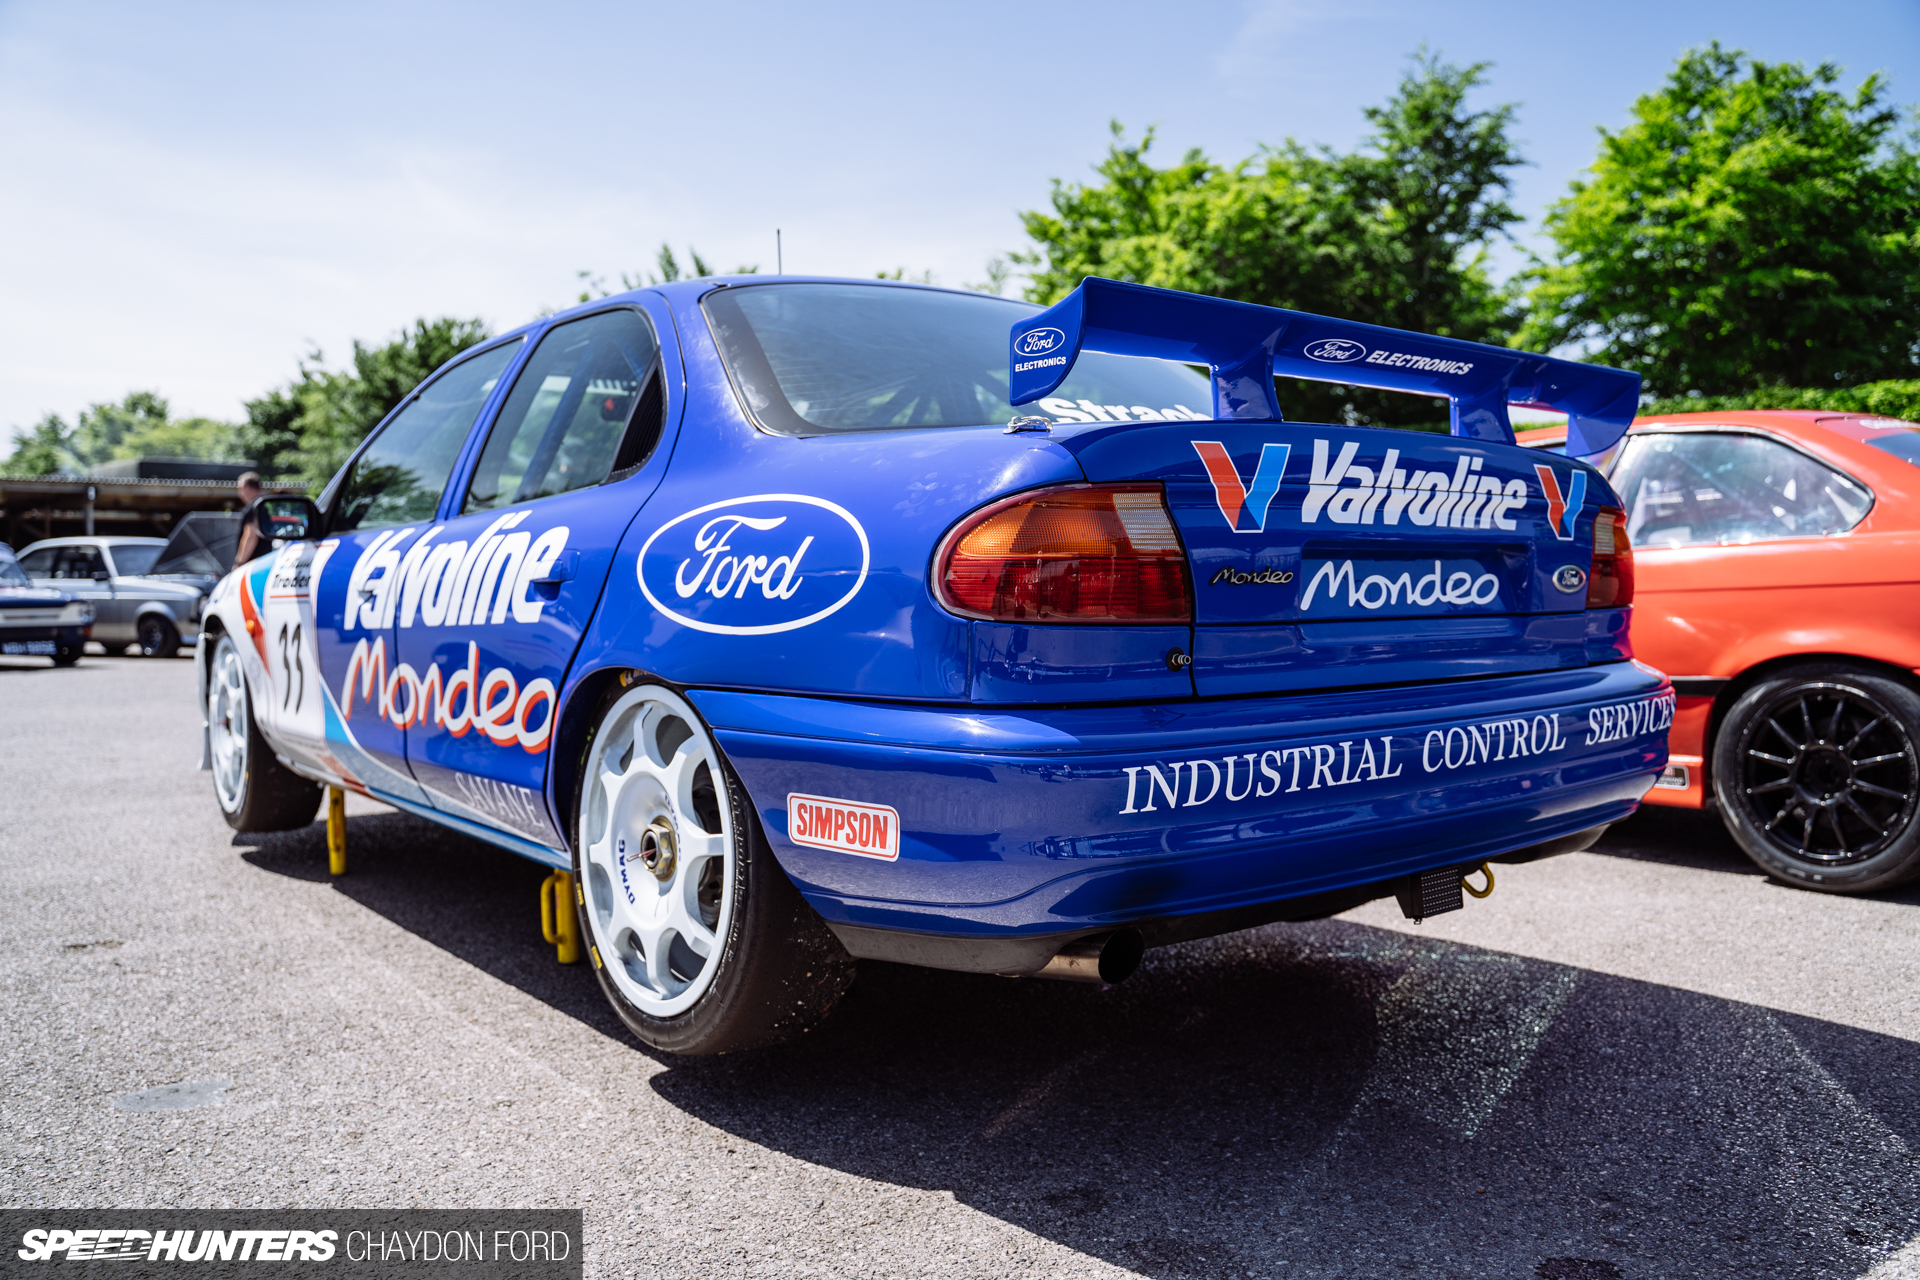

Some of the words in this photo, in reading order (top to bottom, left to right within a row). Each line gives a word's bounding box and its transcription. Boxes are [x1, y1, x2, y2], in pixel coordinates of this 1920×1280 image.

[1015, 356, 1067, 373] ELECTRONICS
[1024, 331, 1054, 352] Ford
[1313, 341, 1356, 360] Ford
[1365, 349, 1474, 376] ELECTRONICS
[1301, 438, 1528, 531] Valvoline
[344, 509, 570, 631] Valvoline
[675, 515, 815, 600] Ford
[1208, 565, 1294, 586] Mondeo
[1301, 558, 1500, 611] Mondeo
[341, 635, 558, 755] Mondeo
[1118, 736, 1402, 816] INDUSTRIAL
[1422, 713, 1567, 773] CONTROL
[1584, 693, 1677, 746] SERVICES
[455, 771, 546, 829] SAVANE
[796, 802, 889, 851] SIMPSON
